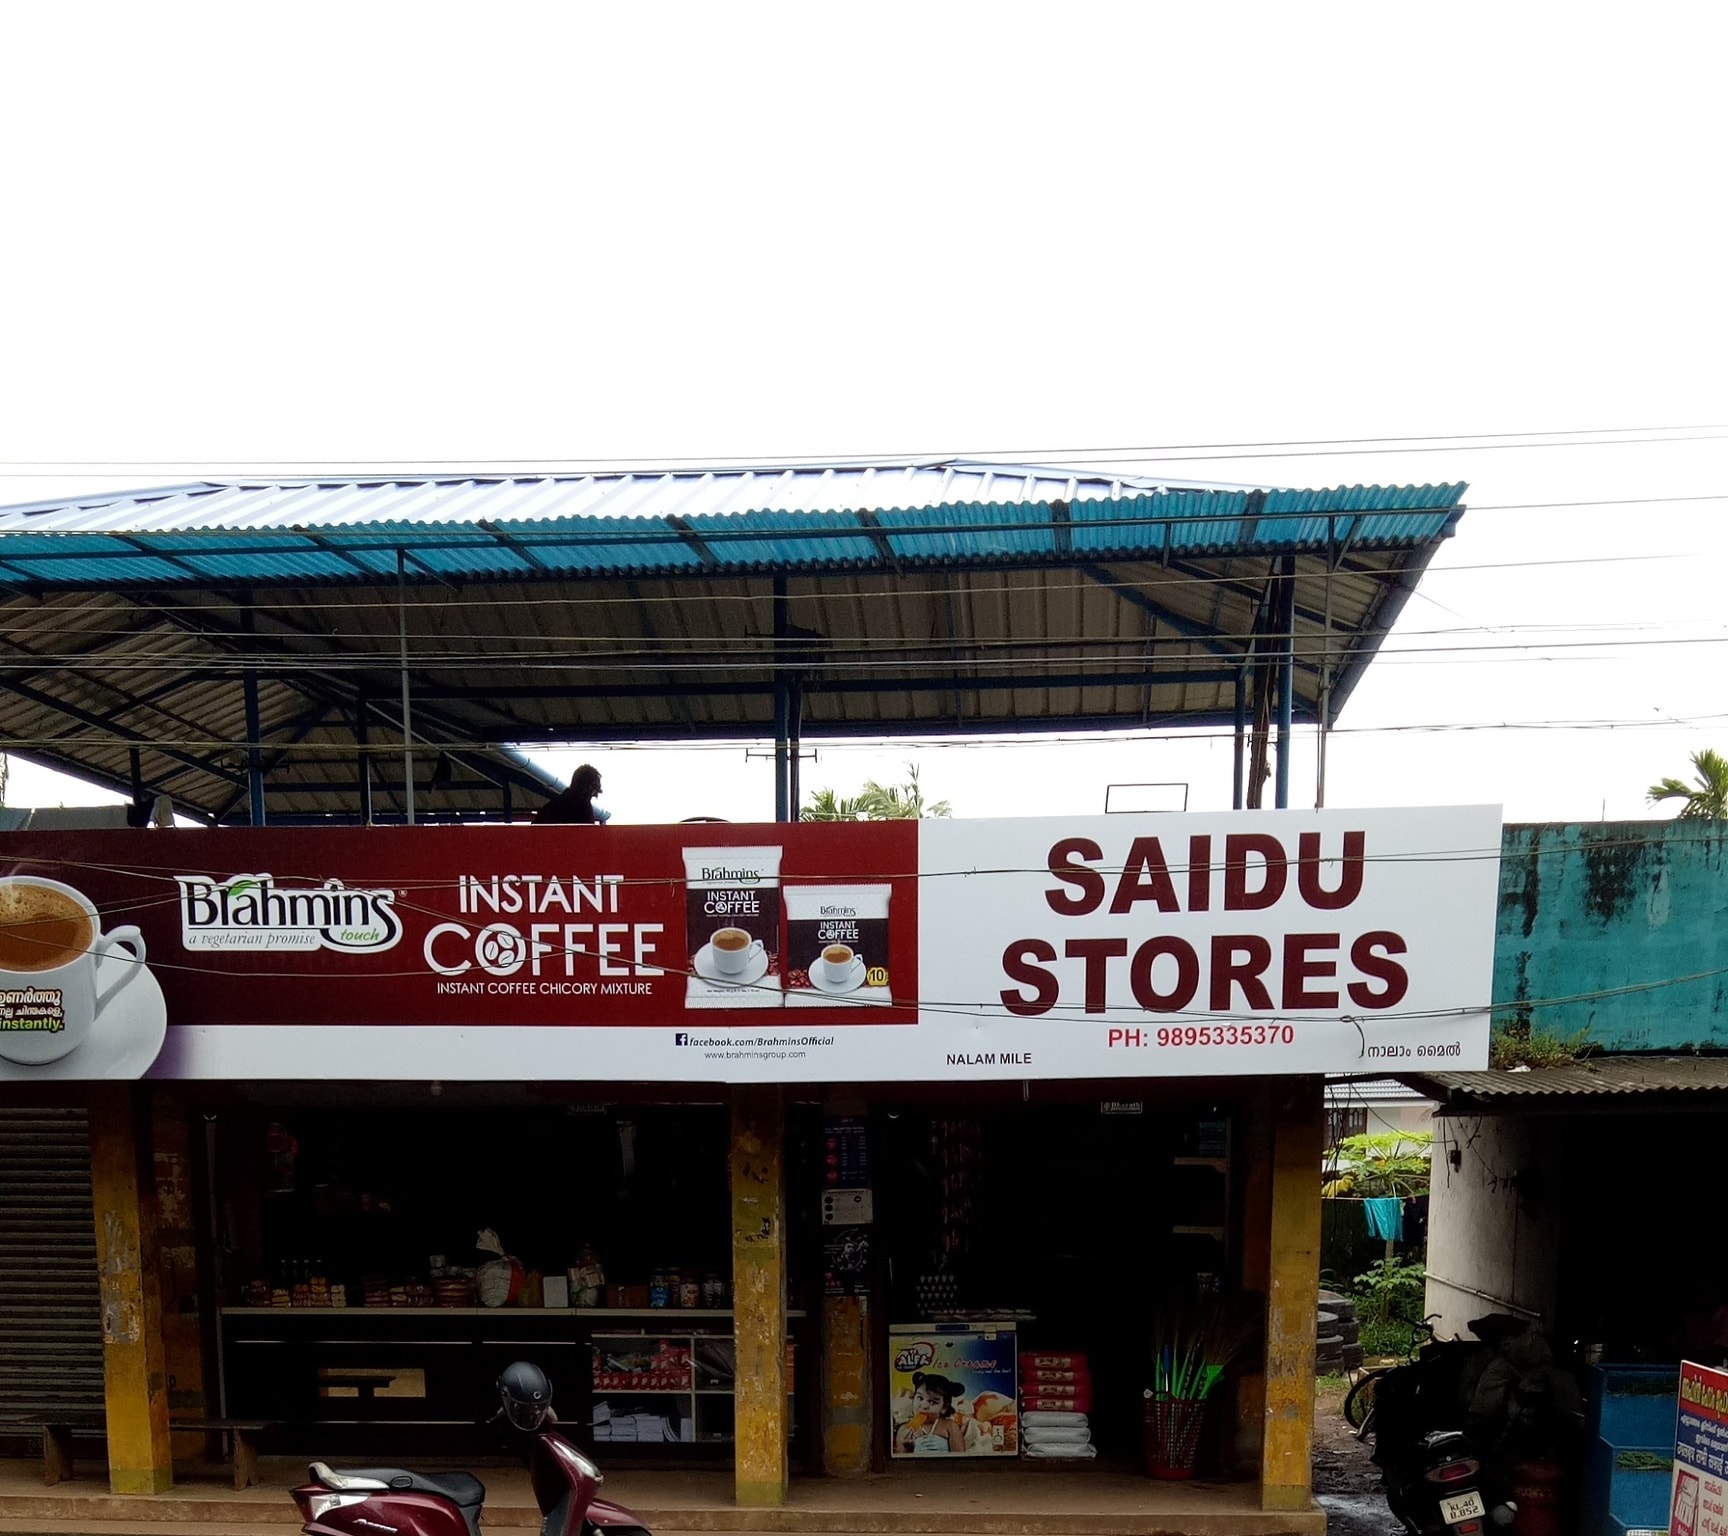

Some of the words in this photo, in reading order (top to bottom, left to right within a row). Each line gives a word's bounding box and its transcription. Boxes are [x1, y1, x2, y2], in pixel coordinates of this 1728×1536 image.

[702, 867, 760, 884] Brahmins
[1045, 831, 1366, 916] SAIDU
[459, 874, 625, 913] INSTANT
[707, 890, 756, 901] INSTANT
[183, 880, 396, 946] Brahmins
[704, 901, 760, 914] COFFEE
[820, 921, 856, 930] INSTANT
[188, 935, 197, 945] a
[201, 931, 262, 949] vegetarian
[266, 933, 316, 949] promise
[340, 928, 380, 941] touch
[817, 929, 859, 940] COFFEE
[424, 922, 665, 977] COFFEE
[1000, 930, 1409, 1017] STORES
[437, 982, 486, 995] INSTANT
[487, 982, 537, 995] COFFEE
[539, 982, 599, 995] CHICORY
[600, 982, 653, 995] MIXTURE
[689, 1036, 835, 1047] facebook.com/BrahminsOfficial
[1108, 1028, 1150, 1048] PH:
[1156, 1025, 1295, 1048] 9895335370
[704, 1050, 806, 1060] www.brahminsgroup.com
[1367, 1045, 1412, 1058] നാലാം
[946, 1053, 996, 1066] NALAM
[999, 1053, 1033, 1065] MILE
